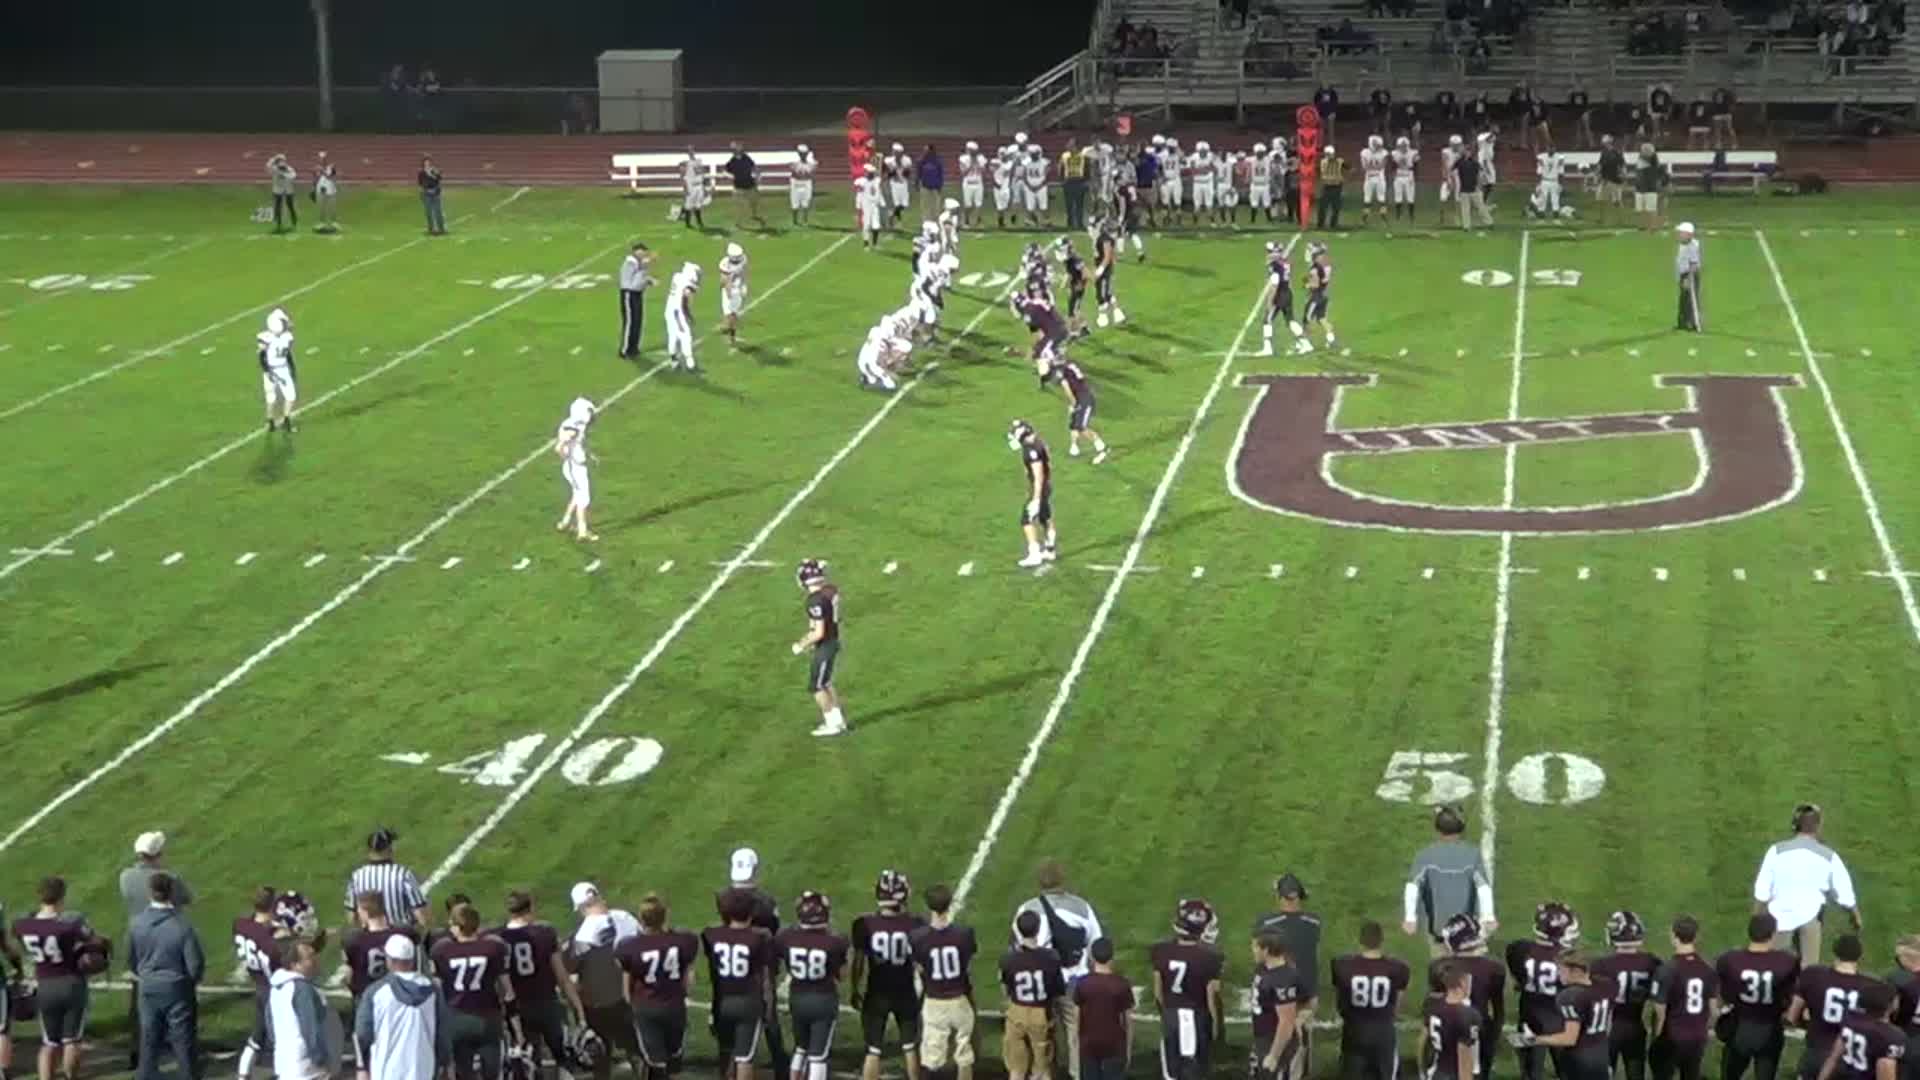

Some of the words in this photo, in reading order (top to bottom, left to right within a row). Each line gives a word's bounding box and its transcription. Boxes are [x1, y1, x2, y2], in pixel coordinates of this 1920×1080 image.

[1461, 269, 1583, 287] 50
[1340, 415, 1674, 449] UNITY
[437, 733, 664, 786] 40
[1375, 751, 1606, 805] 50
[22, 934, 63, 963] 54
[641, 945, 680, 984] 74
[714, 941, 750, 977] 36
[789, 947, 827, 980] 58
[871, 930, 908, 965] 90
[930, 945, 961, 980] 10
[449, 956, 487, 991] 77
[1014, 969, 1048, 1003] 21
[1168, 959, 1187, 994] 7
[1524, 957, 1558, 996] 12
[1740, 969, 1774, 1005] 31
[1351, 975, 1391, 1009] 80
[1686, 977, 1704, 1014] 8
[1823, 987, 1859, 1024] 61
[1429, 1014, 1443, 1051] 5
[1585, 998, 1609, 1035] 11
[1841, 1026, 1869, 1072] 33
